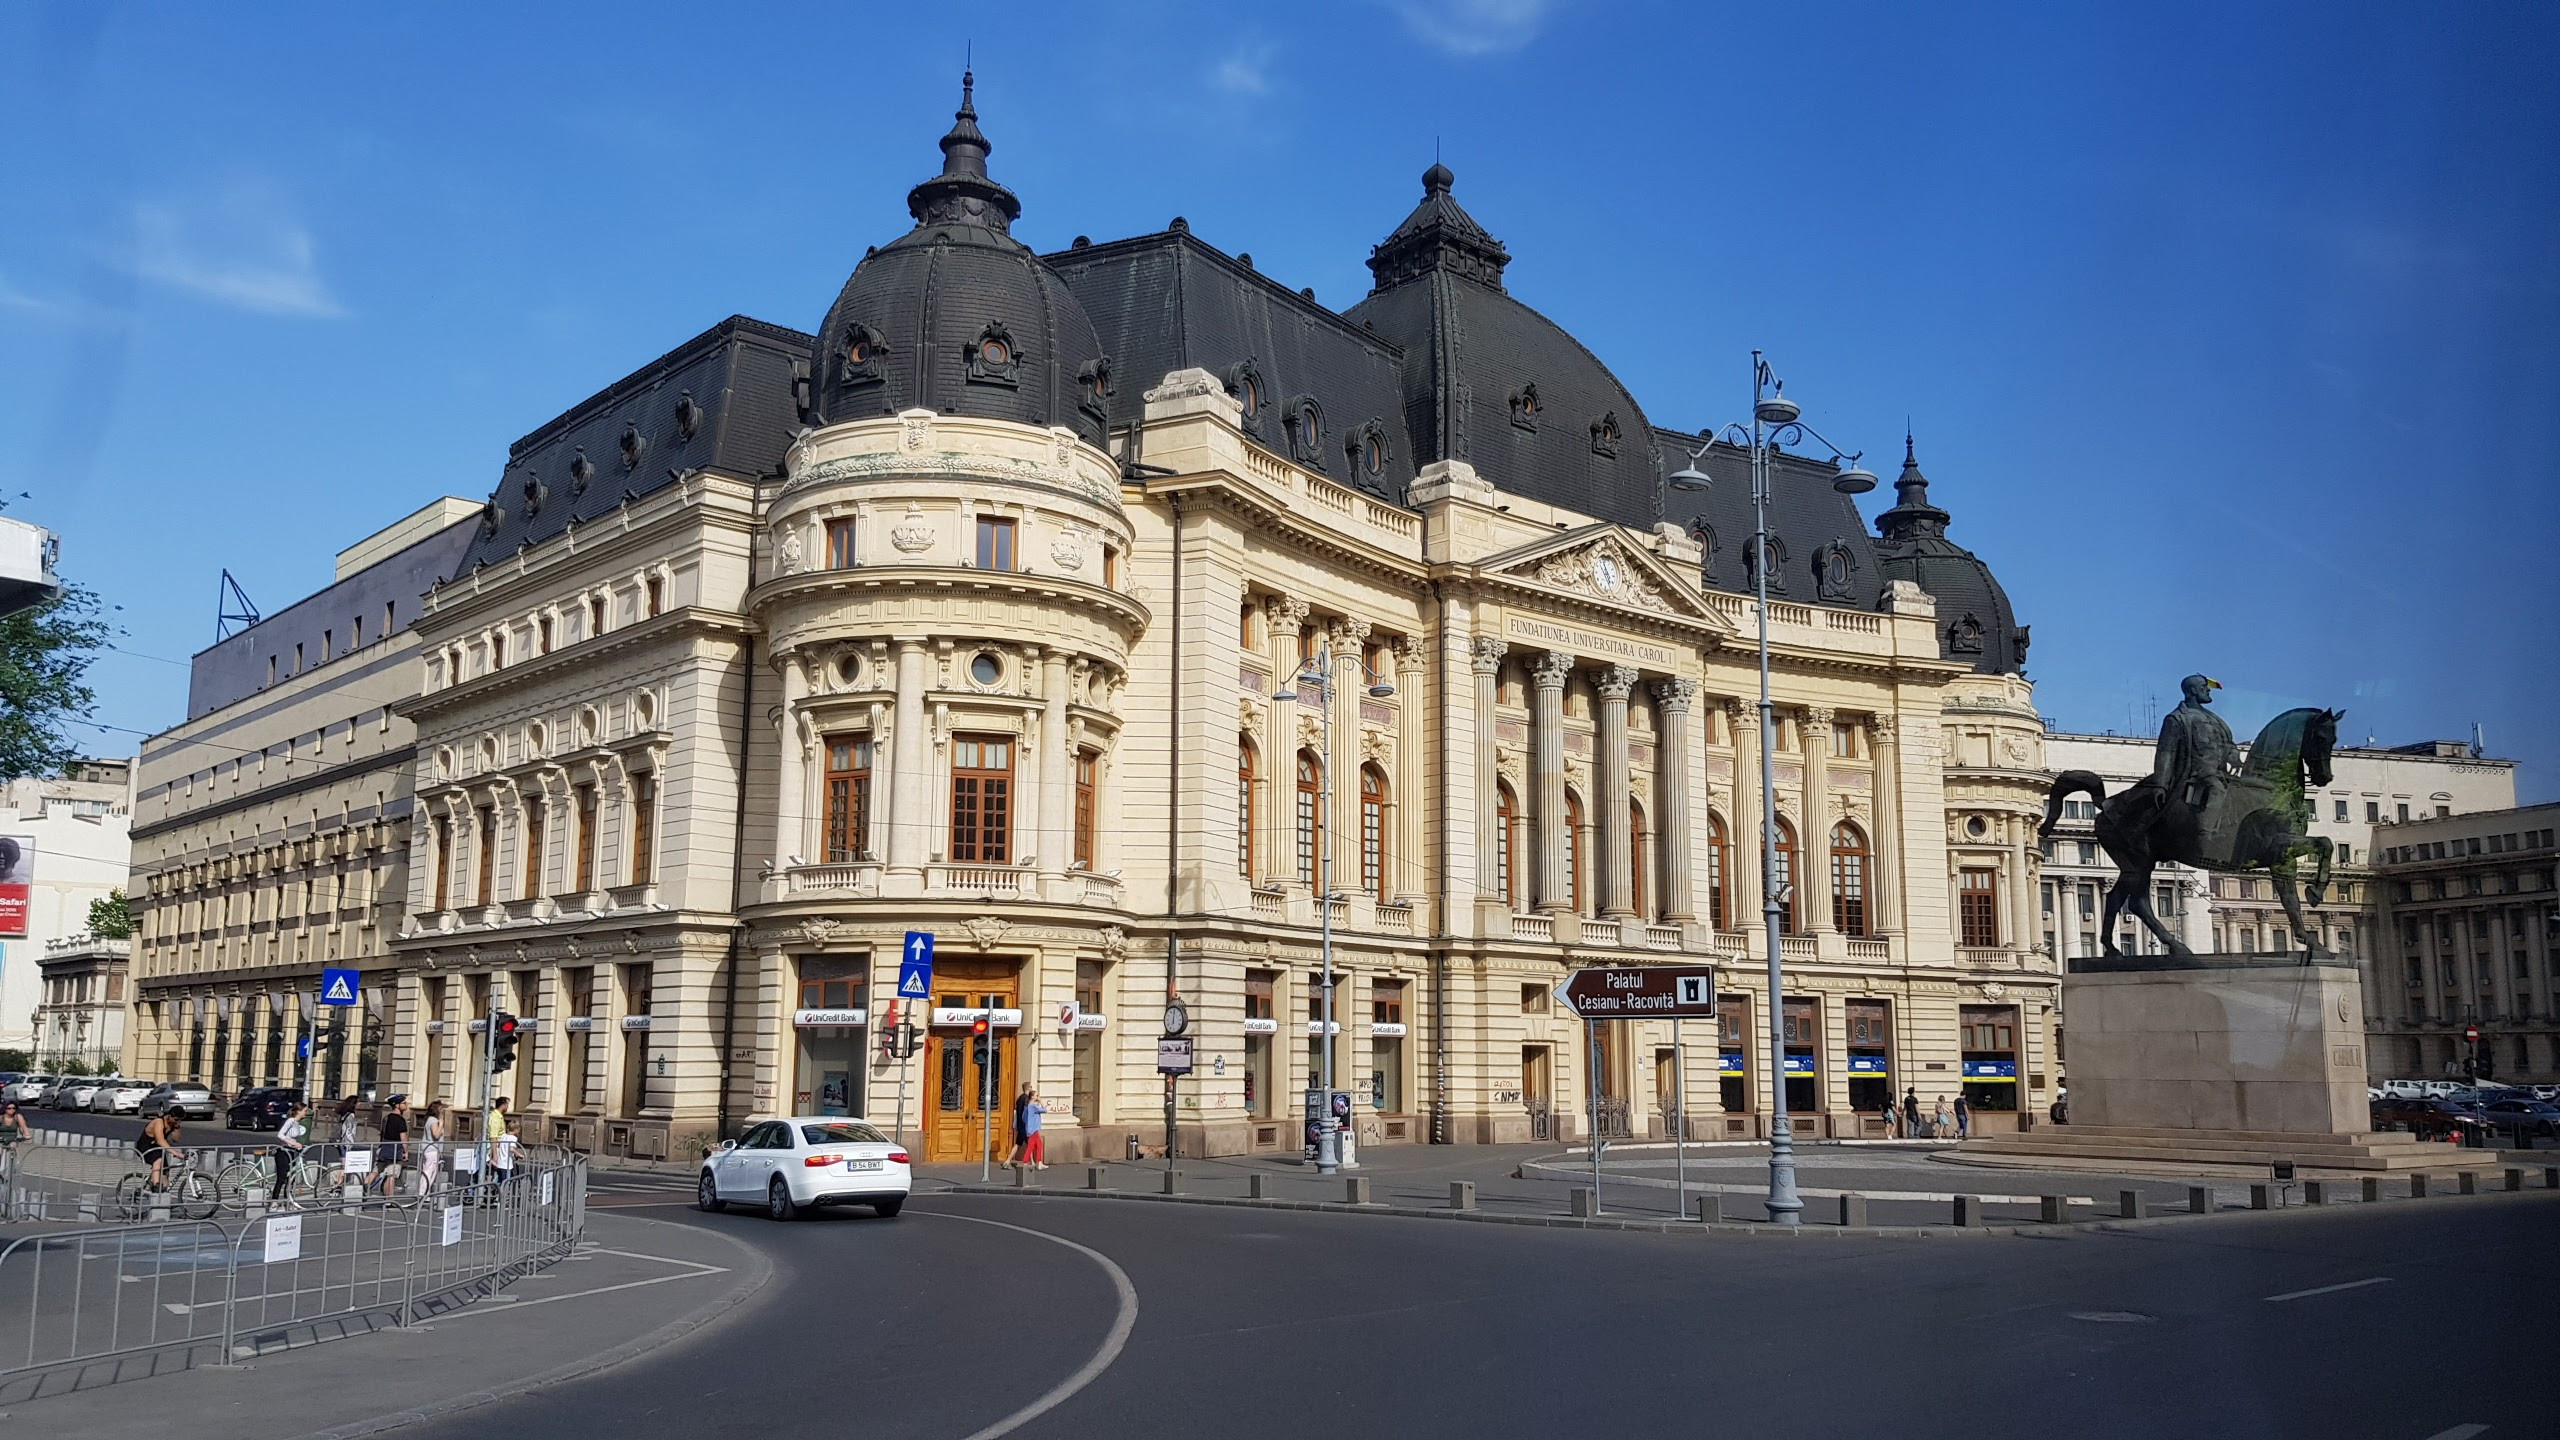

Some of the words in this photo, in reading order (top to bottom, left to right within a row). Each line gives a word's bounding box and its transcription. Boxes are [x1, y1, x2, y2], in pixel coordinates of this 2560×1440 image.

[1510, 618, 1570, 644] FUNDATIUNEA
[1573, 632, 1635, 657] UNIVERSITARA
[1638, 646, 1666, 663] CAROL
[1668, 653, 1672, 665] I
[1606, 972, 1643, 988] Palatul
[813, 1014, 840, 1022] UniCredit
[841, 1014, 857, 1022] Bank
[992, 1014, 1010, 1022] Bank
[853, 1161, 857, 1169] B
